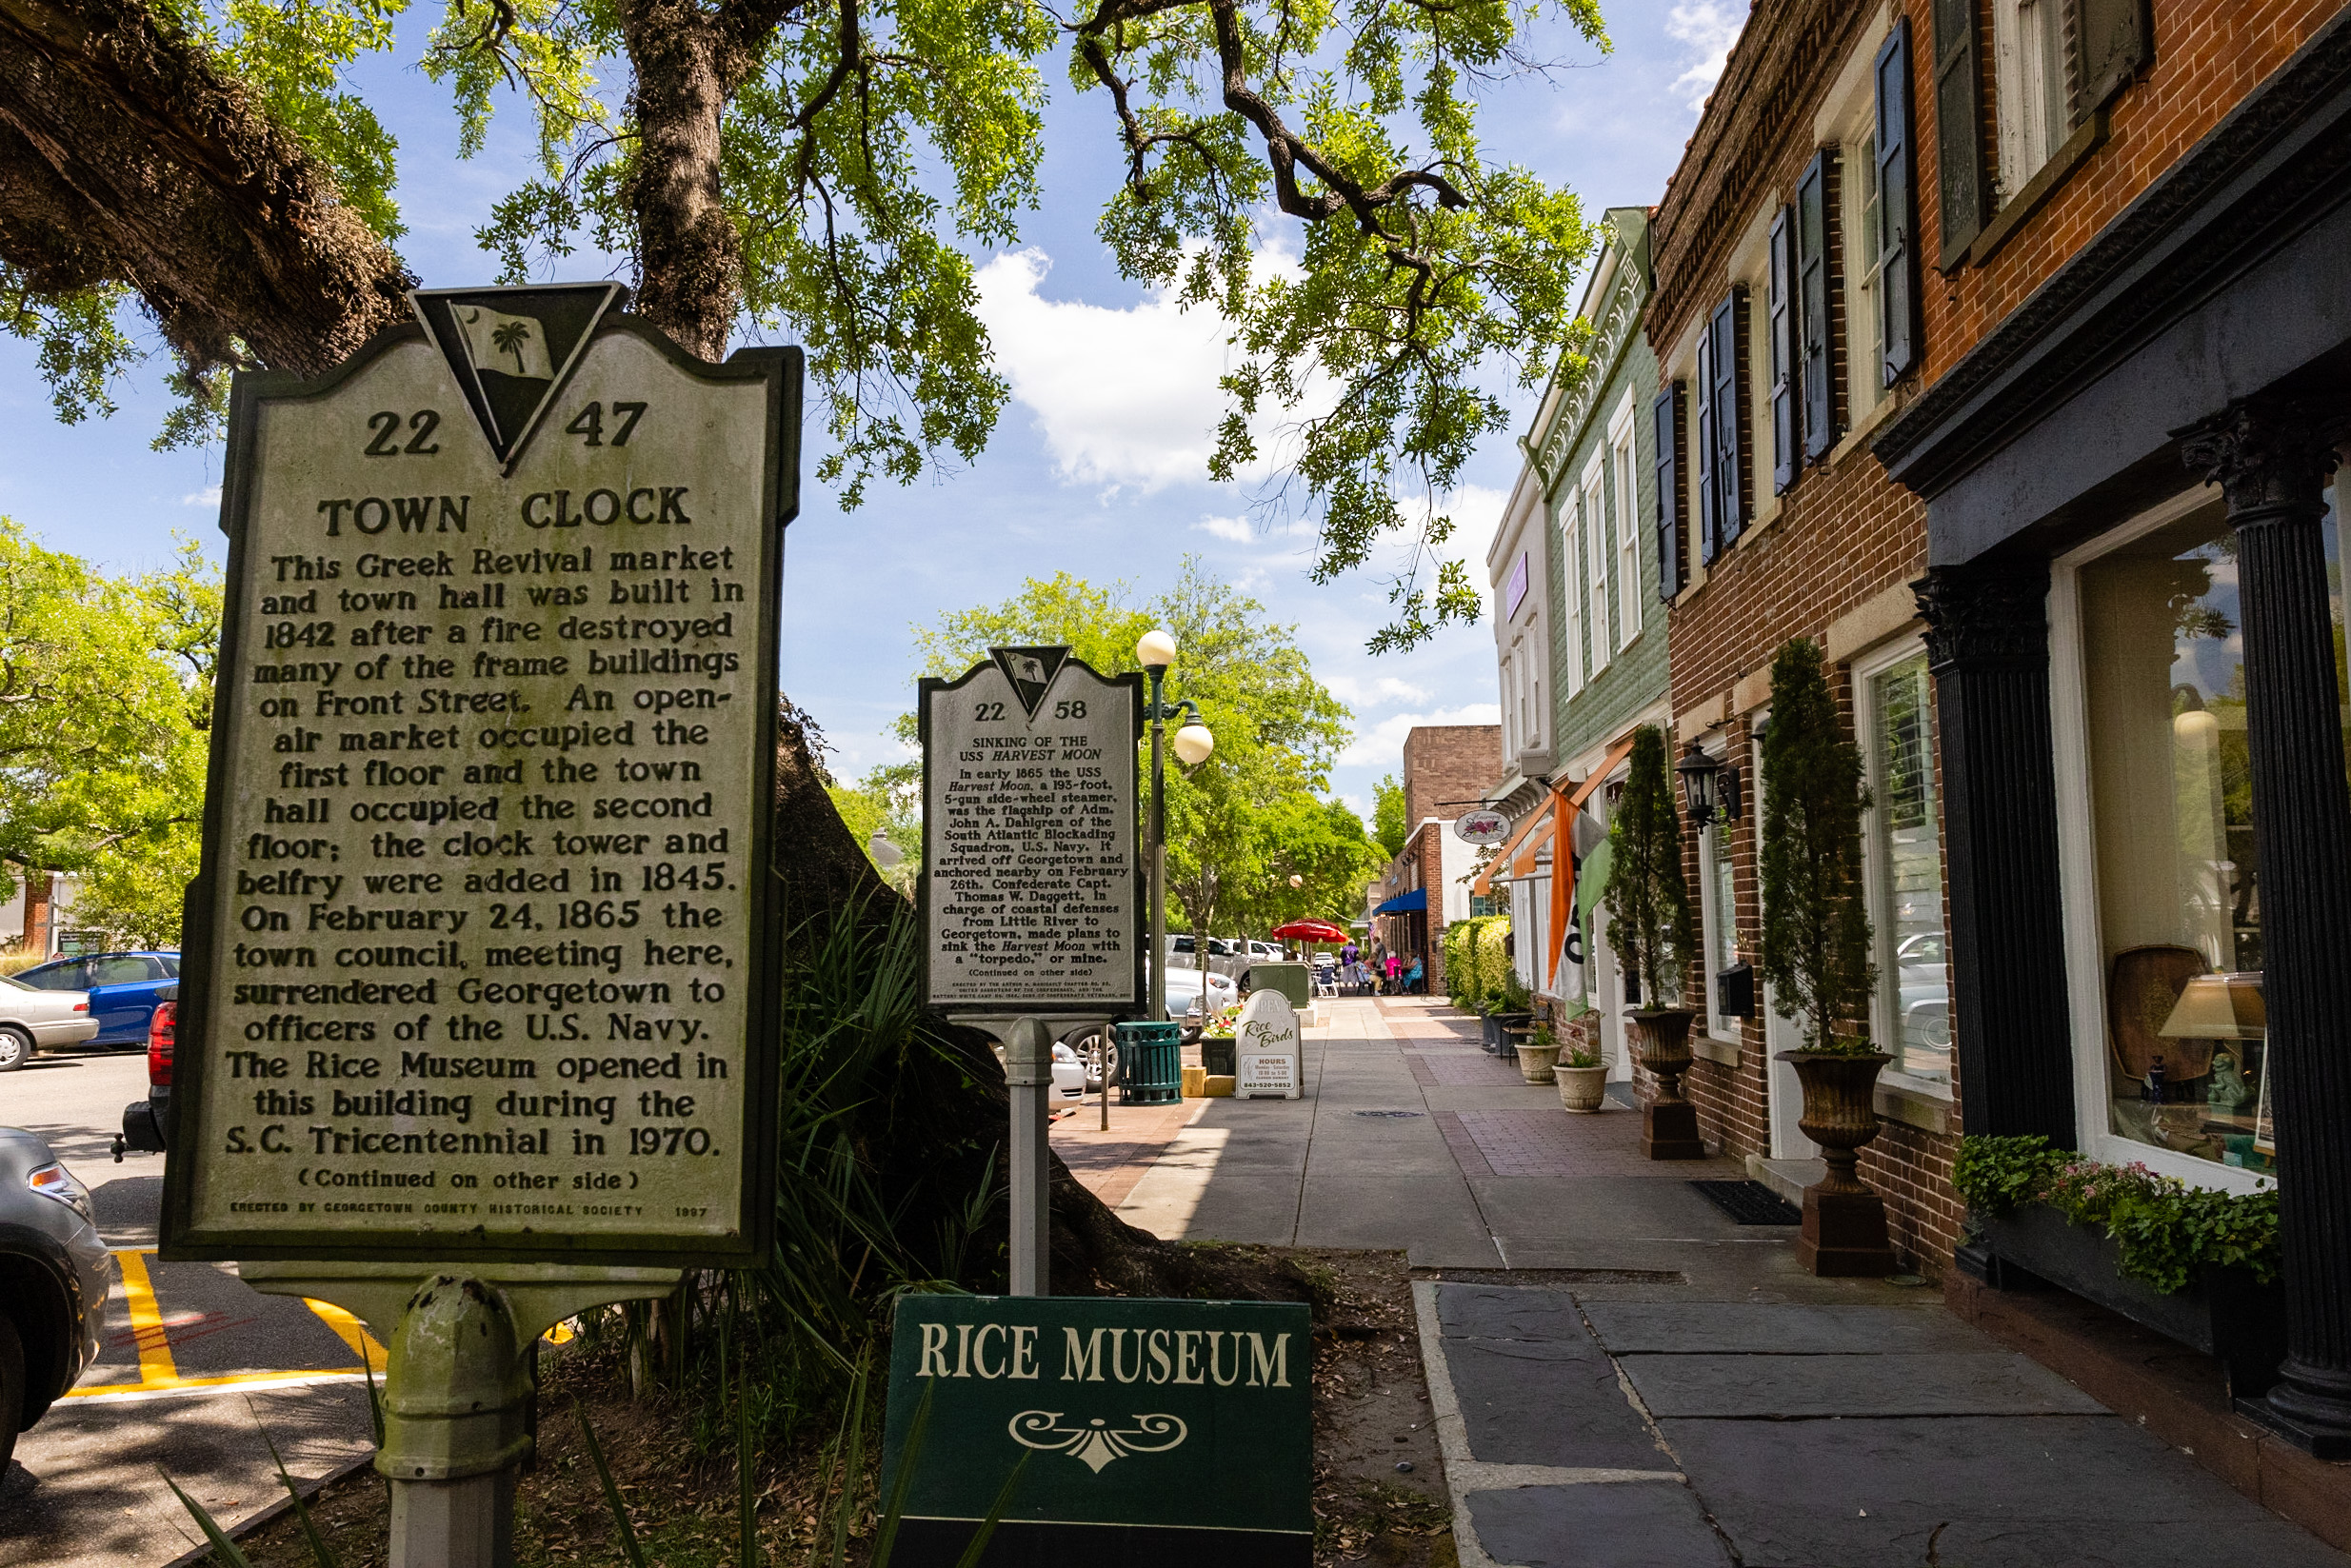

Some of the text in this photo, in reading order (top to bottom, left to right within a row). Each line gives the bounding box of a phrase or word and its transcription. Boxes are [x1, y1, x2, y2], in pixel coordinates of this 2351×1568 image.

[364, 401, 648, 458] 22 47
[317, 488, 691, 539] TOWN CLOCK
[270, 545, 734, 585] This Greek Revival market
[265, 612, 733, 651] 1842 after a fire destroyed
[259, 684, 732, 718] on Front Street. An open-
[975, 701, 1086, 722] 22 58
[973, 736, 1087, 747] SINKING OF THE
[960, 748, 1102, 762] USS HARVEST MOON
[279, 756, 703, 789] first floor and the town
[960, 767, 1101, 780] In early 1865 the USS
[948, 782, 995, 791] Harvest
[945, 794, 981, 806] 5-gun
[986, 792, 1055, 804] side-wheel
[975, 805, 995, 815] the
[1002, 805, 1053, 819] flagship
[1060, 804, 1074, 815] of
[1080, 804, 1114, 814] Adm.
[949, 817, 1112, 830] John A. Dahlgren of the
[945, 828, 1115, 841] South Atlantic Blockading
[247, 828, 729, 863] floor; the clock tower and
[1023, 842, 1047, 852] U.S.
[1053, 842, 1089, 853] Navy.
[1101, 841, 1111, 851] It
[939, 853, 1123, 866] arrived off Georgetown and
[934, 866, 991, 877] anchored
[996, 866, 1041, 878] nearby
[1069, 866, 1128, 878] February
[950, 878, 1111, 892] 26th. Confederate Capt.
[955, 892, 1004, 902] Thomas
[1009, 891, 1023, 901] W.
[1094, 891, 1106, 901] in
[943, 903, 1119, 916] charge of coastal defenses
[240, 905, 290, 933] On
[307, 903, 468, 935] February
[557, 900, 641, 930] 1865
[661, 902, 727, 929] the
[963, 916, 1099, 926] from Little River to
[1028, 928, 1061, 939] made
[1067, 928, 1101, 941] plans
[1106, 927, 1120, 938] to
[941, 941, 1120, 951] sink the Harvest Moon with
[1070, 953, 1107, 963] mine.
[233, 978, 726, 1009] surrendered Georgetown to
[244, 1013, 711, 1045] officers of the U.S. Navy.
[1243, 1021, 1272, 1037] Rice
[1257, 1028, 1293, 1047] Birds
[225, 1051, 728, 1083] The Rice Museum opened in
[297, 1167, 639, 1190] (Continued on other side)
[230, 1202, 711, 1220] ERECTED BY GEORGETOWN COUNTY HISTORICAL SOCIETY 1997
[915, 1322, 1292, 1388] RICE MUSEUM
